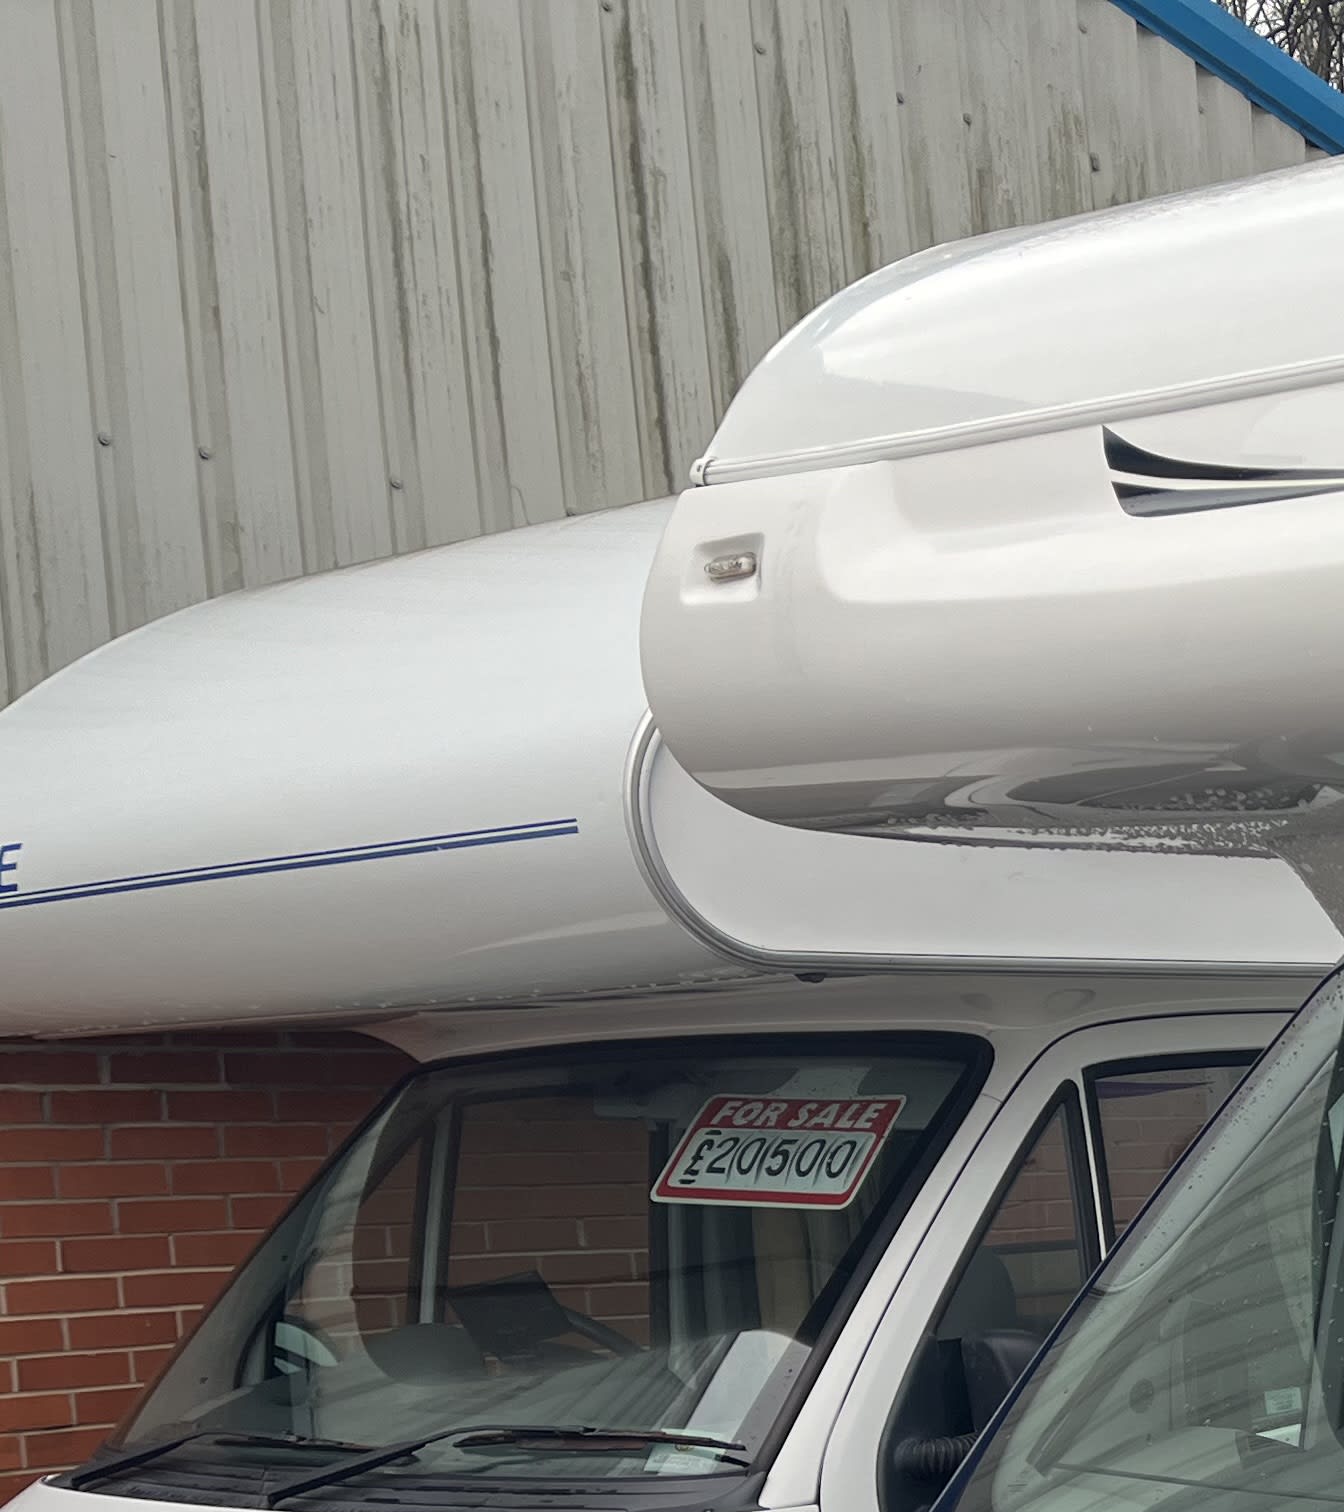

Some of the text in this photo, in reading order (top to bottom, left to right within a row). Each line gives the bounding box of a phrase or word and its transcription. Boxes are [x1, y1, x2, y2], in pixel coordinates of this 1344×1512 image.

[711, 1101, 887, 1129] FOR SALE
[683, 1137, 857, 1179] £20500
